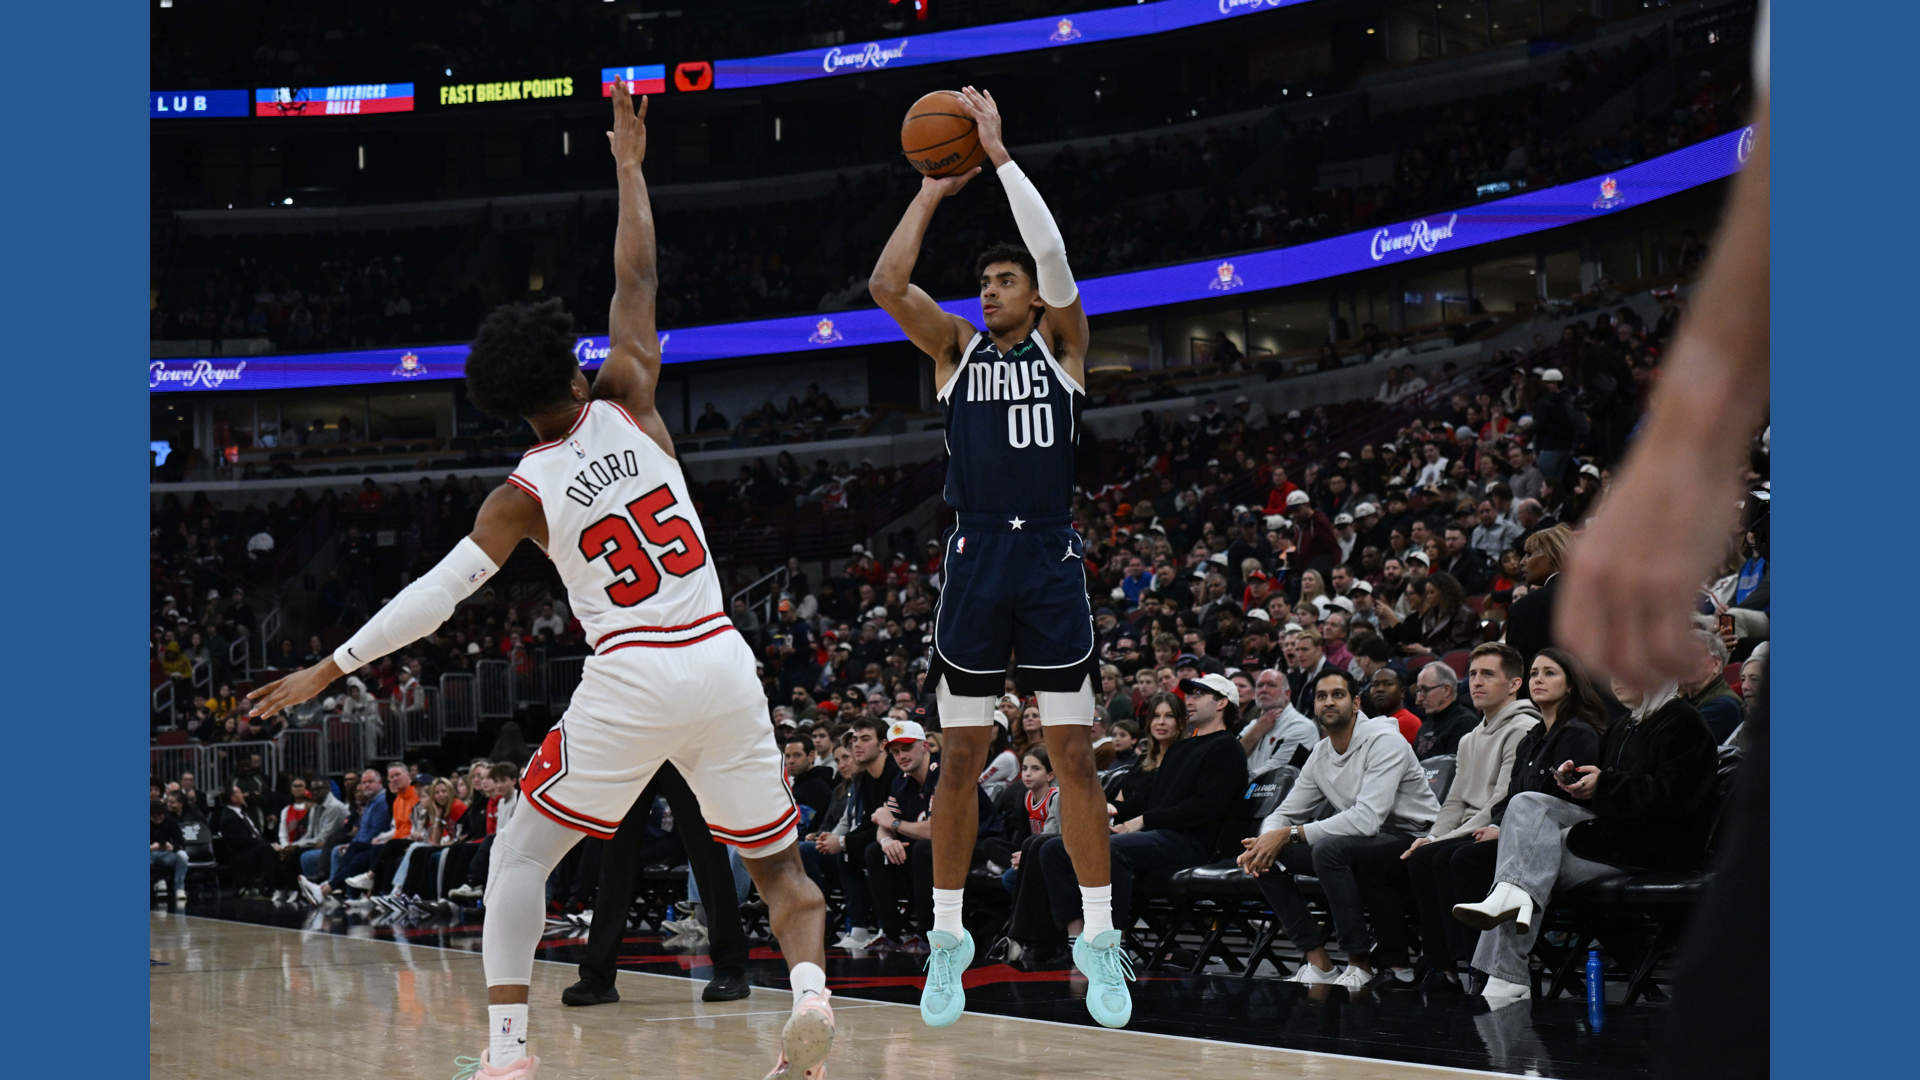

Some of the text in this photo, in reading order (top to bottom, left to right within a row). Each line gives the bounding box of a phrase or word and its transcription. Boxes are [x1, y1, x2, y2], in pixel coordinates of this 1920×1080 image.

[856, 38, 908, 69] Royal
[325, 100, 361, 114] BULLS
[326, 83, 388, 101] MAVERICKS
[440, 76, 573, 105] FAST BREAK POINTS
[1371, 213, 1458, 261] Crown Royal
[183, 359, 247, 388] Royal
[966, 359, 1050, 402] MAVS
[1007, 403, 1055, 449] 00
[566, 450, 639, 507] OKORO
[577, 482, 707, 608] 35
